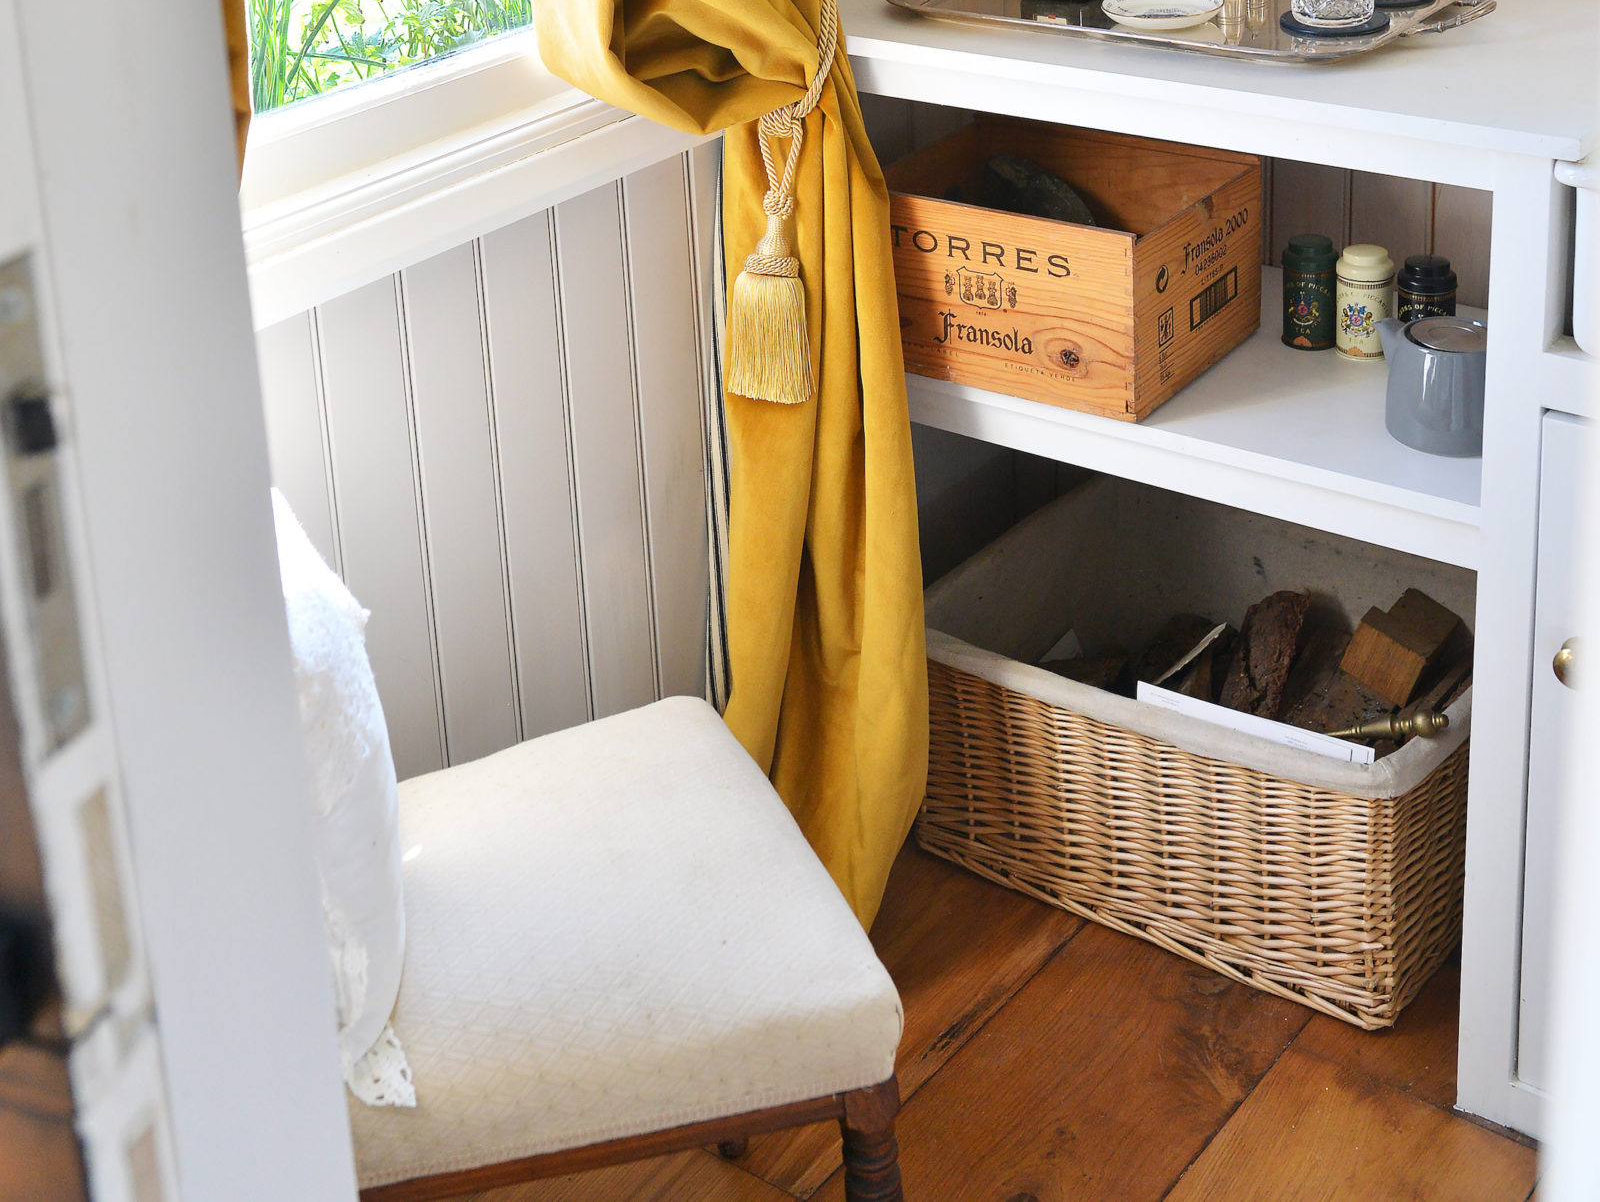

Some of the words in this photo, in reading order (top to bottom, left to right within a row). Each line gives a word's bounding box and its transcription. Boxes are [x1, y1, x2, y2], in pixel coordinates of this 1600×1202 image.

[891, 224, 1071, 279] TORRES
[1181, 226, 1224, 275] Fransola
[1225, 207, 1249, 236] 2000
[933, 309, 1034, 355] Fransola
[1004, 362, 1045, 375] ETIQUETA
